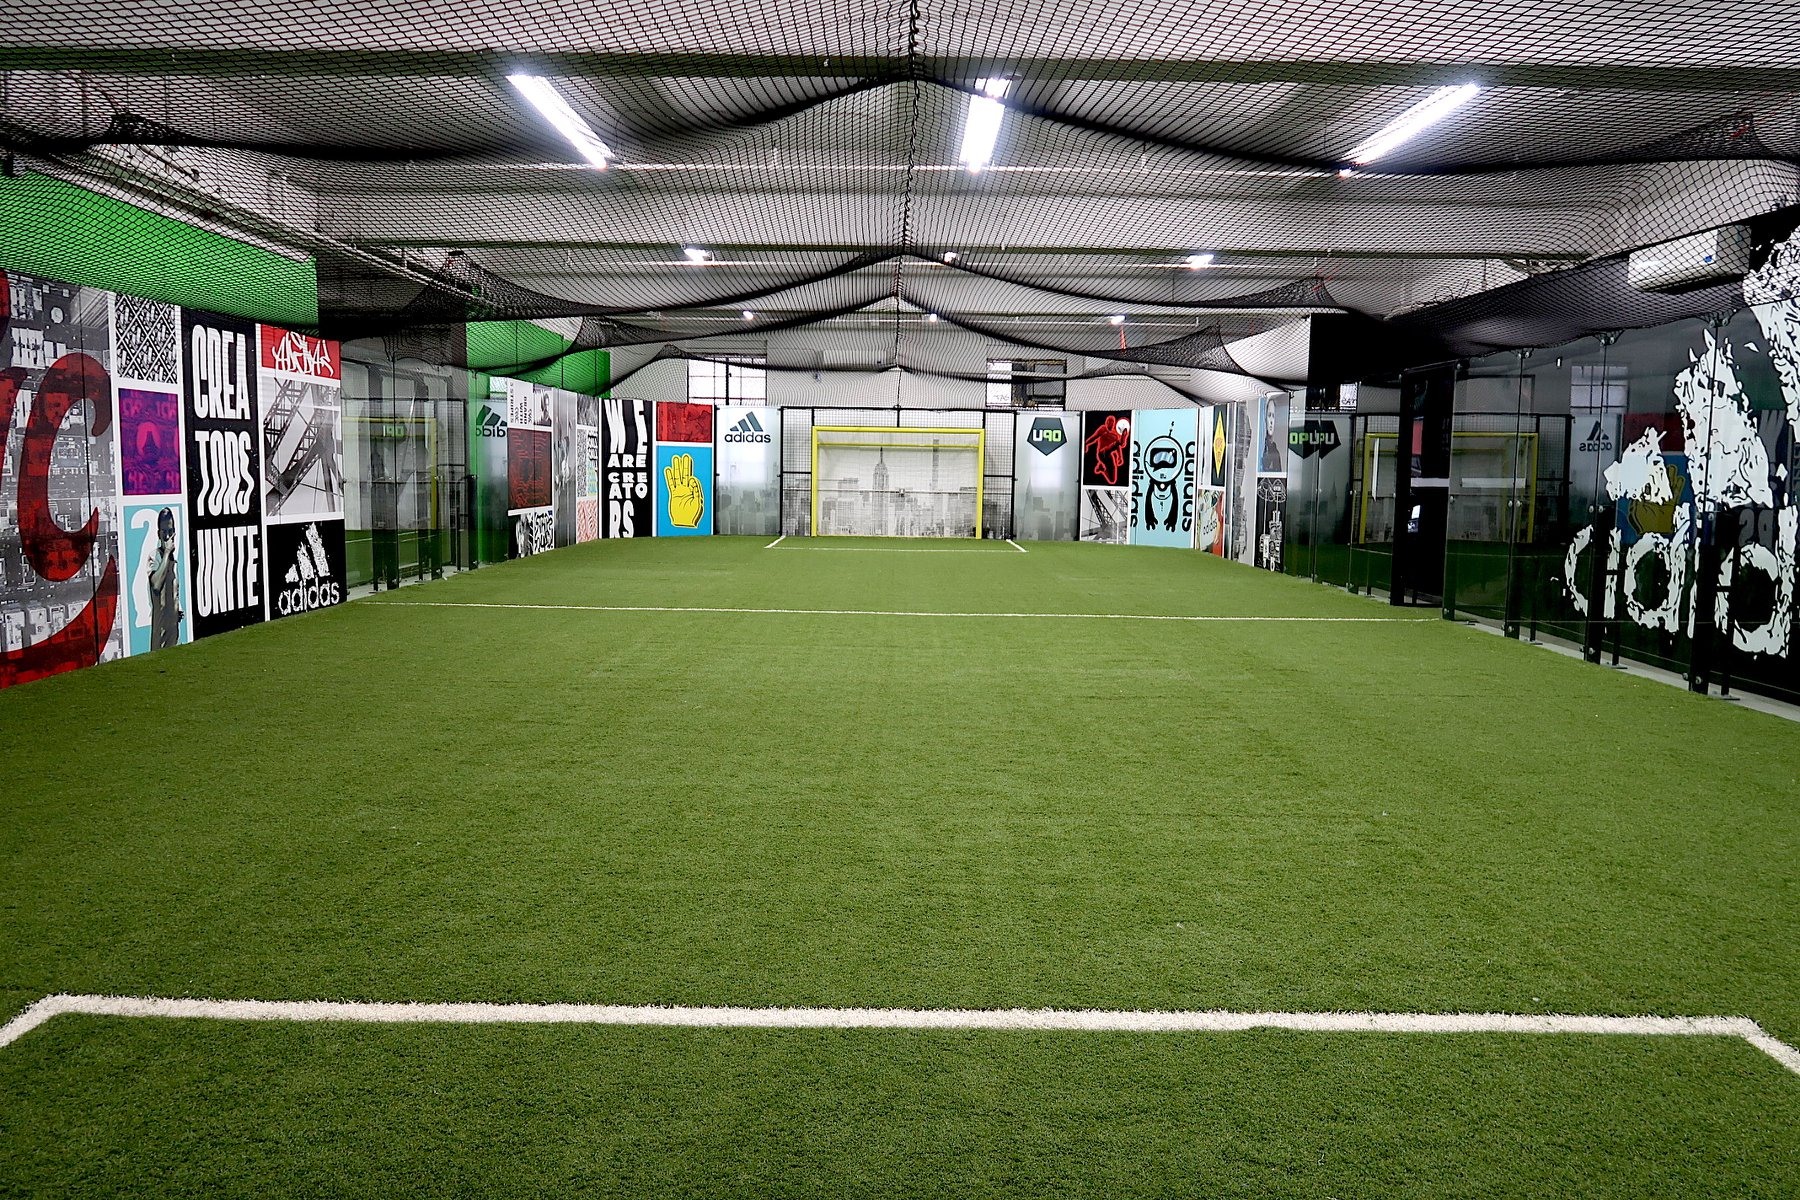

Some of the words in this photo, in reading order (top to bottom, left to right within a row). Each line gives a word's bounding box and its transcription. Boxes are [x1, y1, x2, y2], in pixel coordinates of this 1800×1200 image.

[604, 400, 648, 454] WE
[724, 431, 772, 443] adidas
[607, 453, 647, 468] ARE
[607, 471, 648, 483] CRE
[608, 482, 648, 499] ATO
[608, 500, 634, 538] RS
[196, 525, 259, 617] UNITE
[278, 575, 340, 616] adidas
